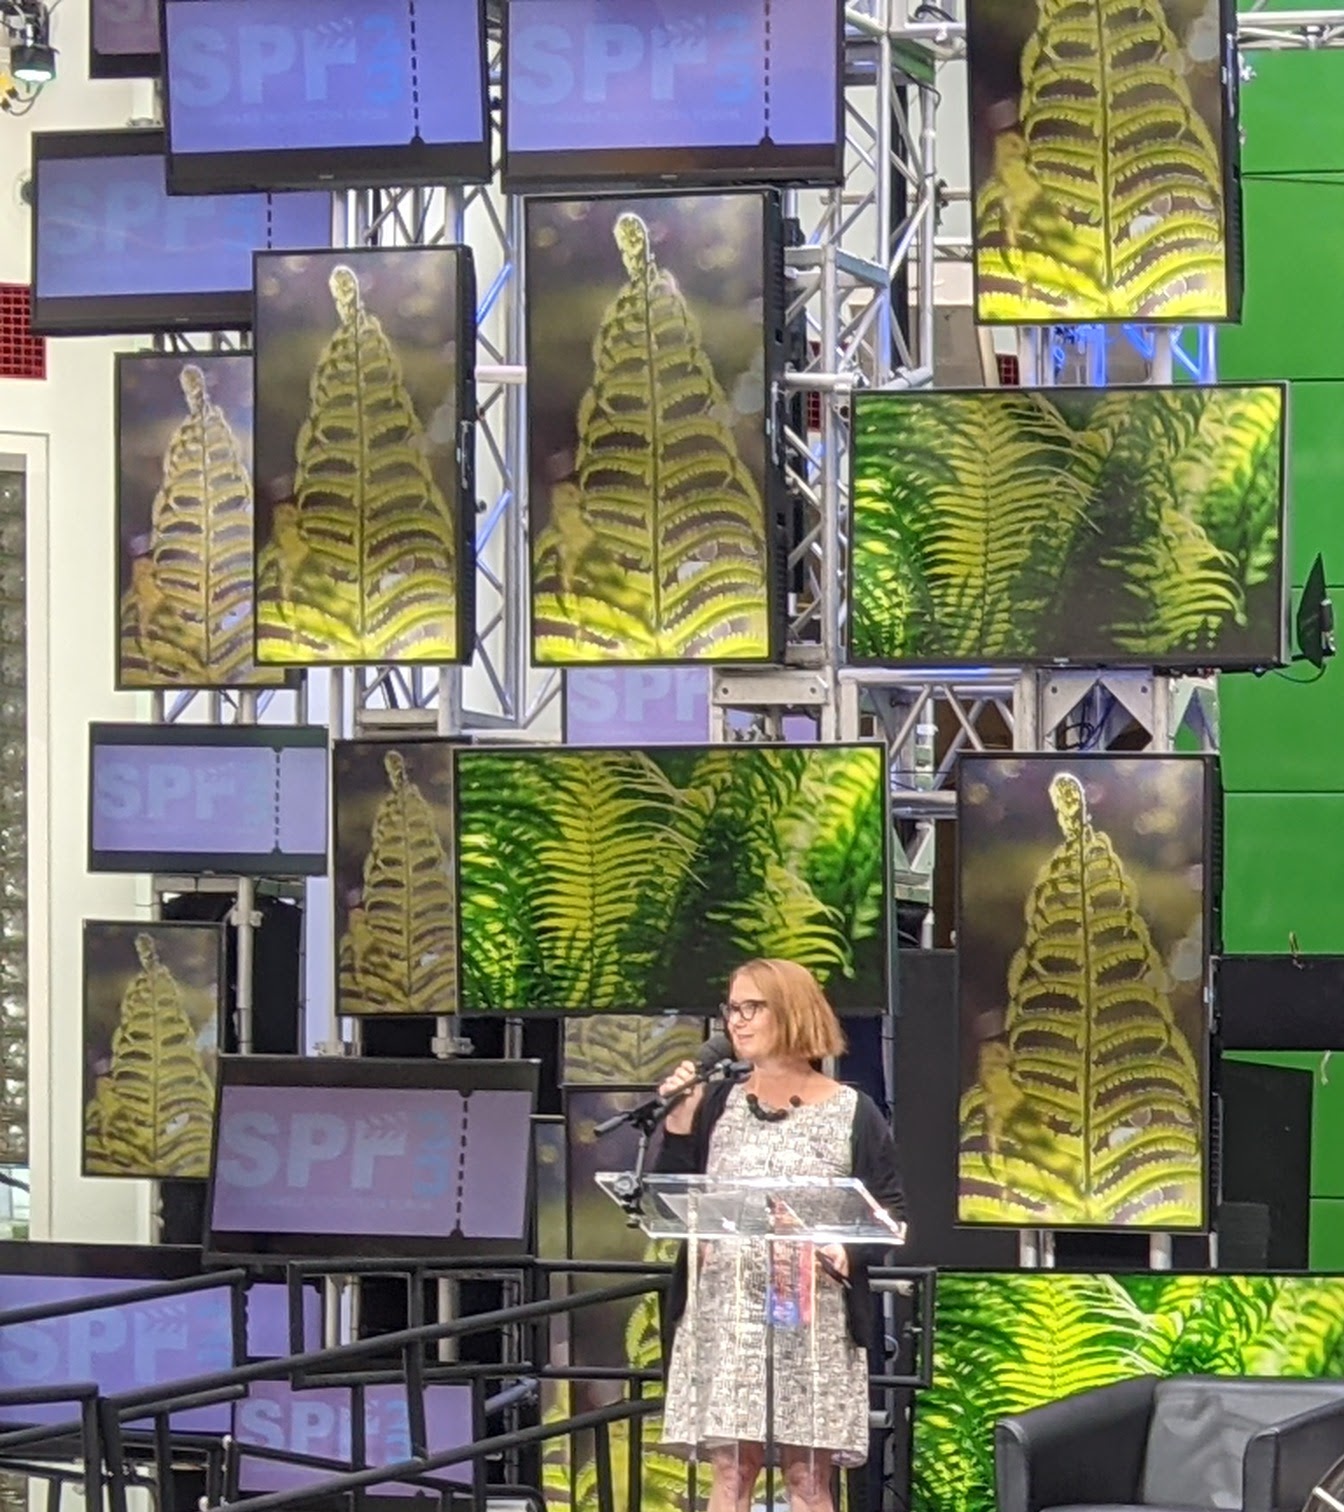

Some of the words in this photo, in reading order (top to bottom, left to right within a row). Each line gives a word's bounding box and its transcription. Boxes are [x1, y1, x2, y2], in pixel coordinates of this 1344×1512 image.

[172, 17, 358, 107] SPF
[512, 17, 708, 105] SPF
[98, 761, 235, 820] SPF
[219, 1110, 409, 1190] SPF
